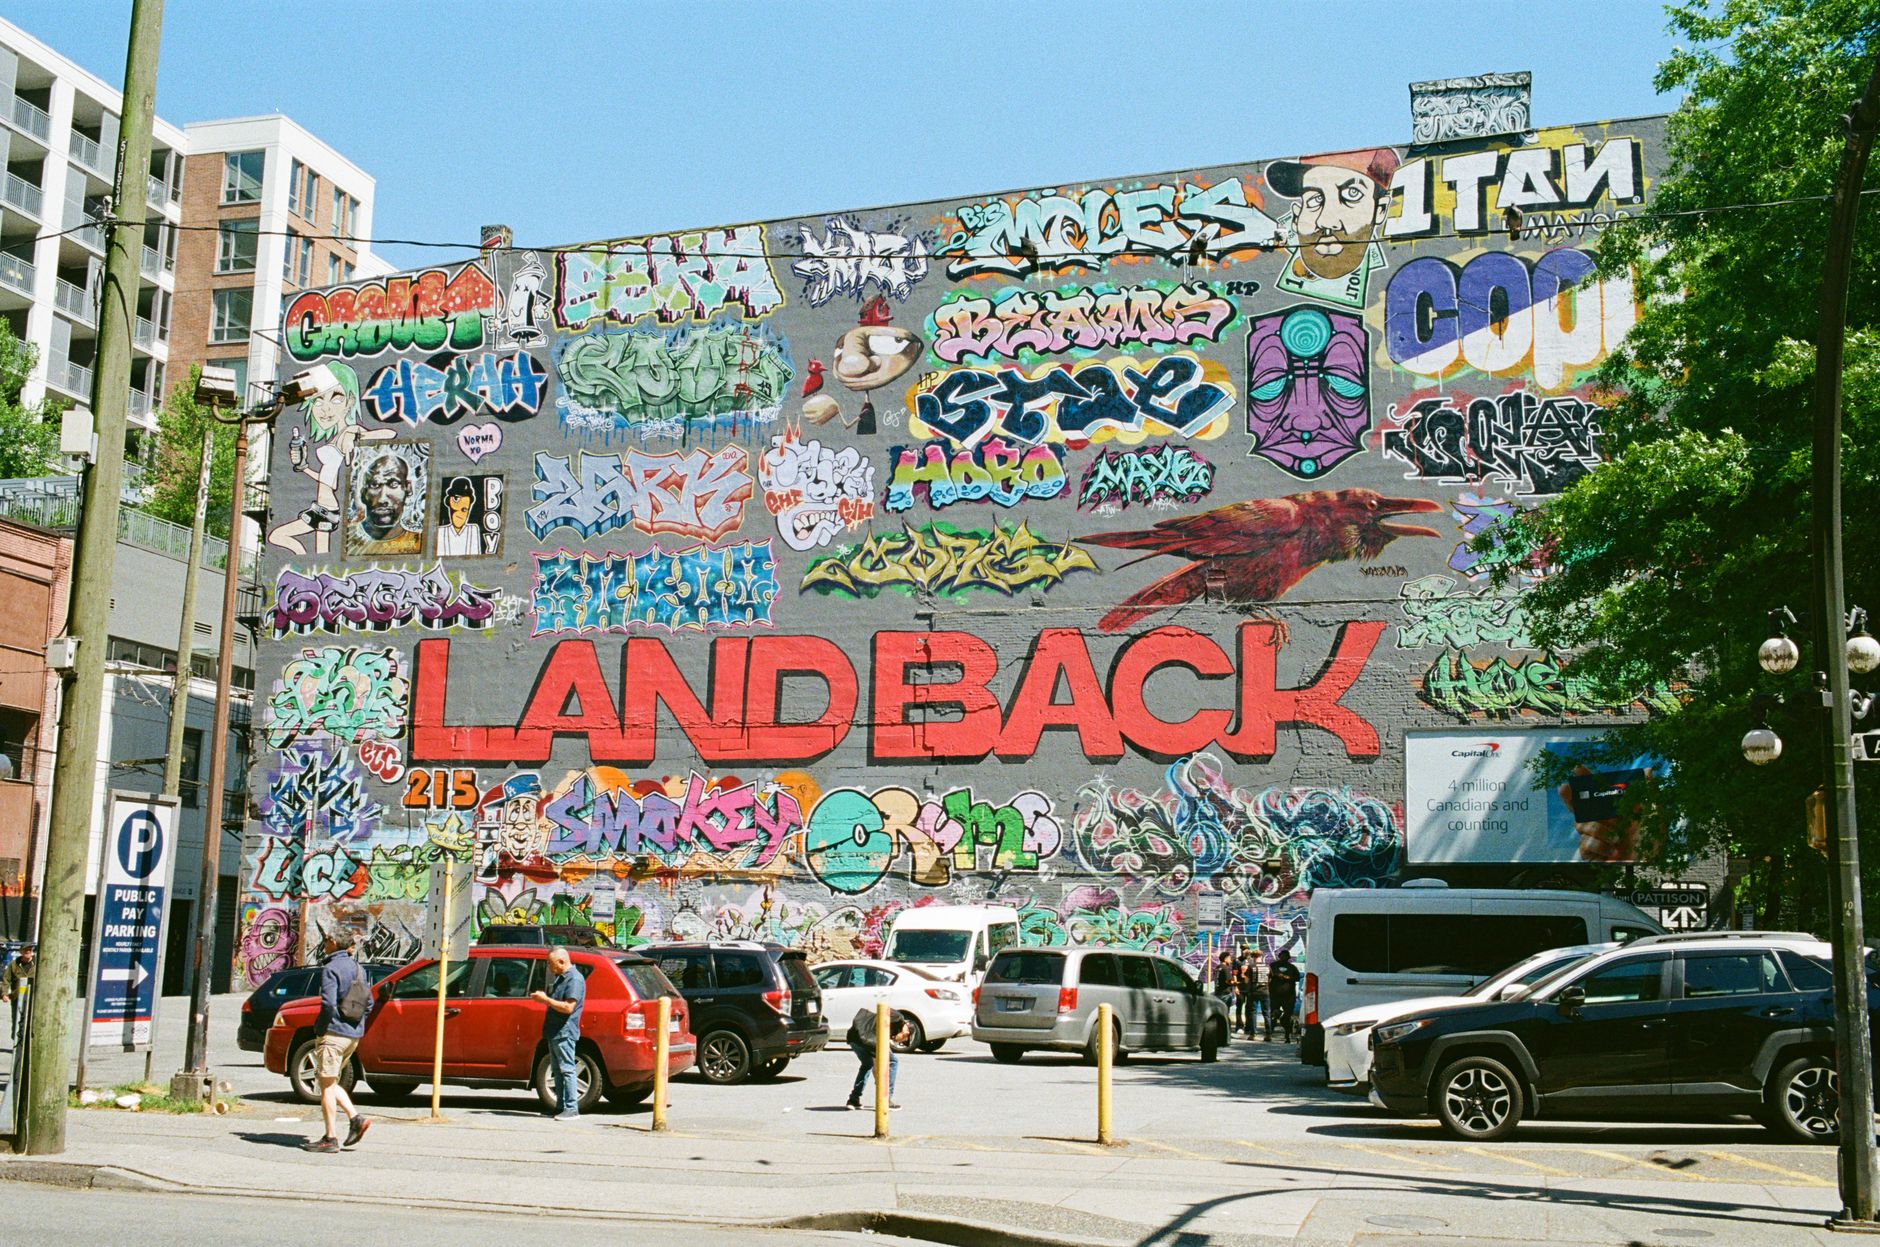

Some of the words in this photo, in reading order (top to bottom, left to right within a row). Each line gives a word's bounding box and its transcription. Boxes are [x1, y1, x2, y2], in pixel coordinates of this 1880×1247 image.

[464, 434, 494, 445] NORMA
[884, 437, 1068, 512] HOBO
[402, 767, 480, 812] 215
[1447, 779, 1456, 791] 4
[1461, 778, 1506, 792] million
[1426, 798, 1499, 812] Canadians
[1503, 798, 1529, 812] and
[544, 768, 804, 869] SMOKEY
[1447, 817, 1508, 834] counting
[127, 818, 157, 872] P
[114, 889, 156, 903] PUBLIC
[1637, 893, 1700, 904] PATTISON
[121, 907, 144, 920] PAY
[104, 924, 157, 938] PARKING
